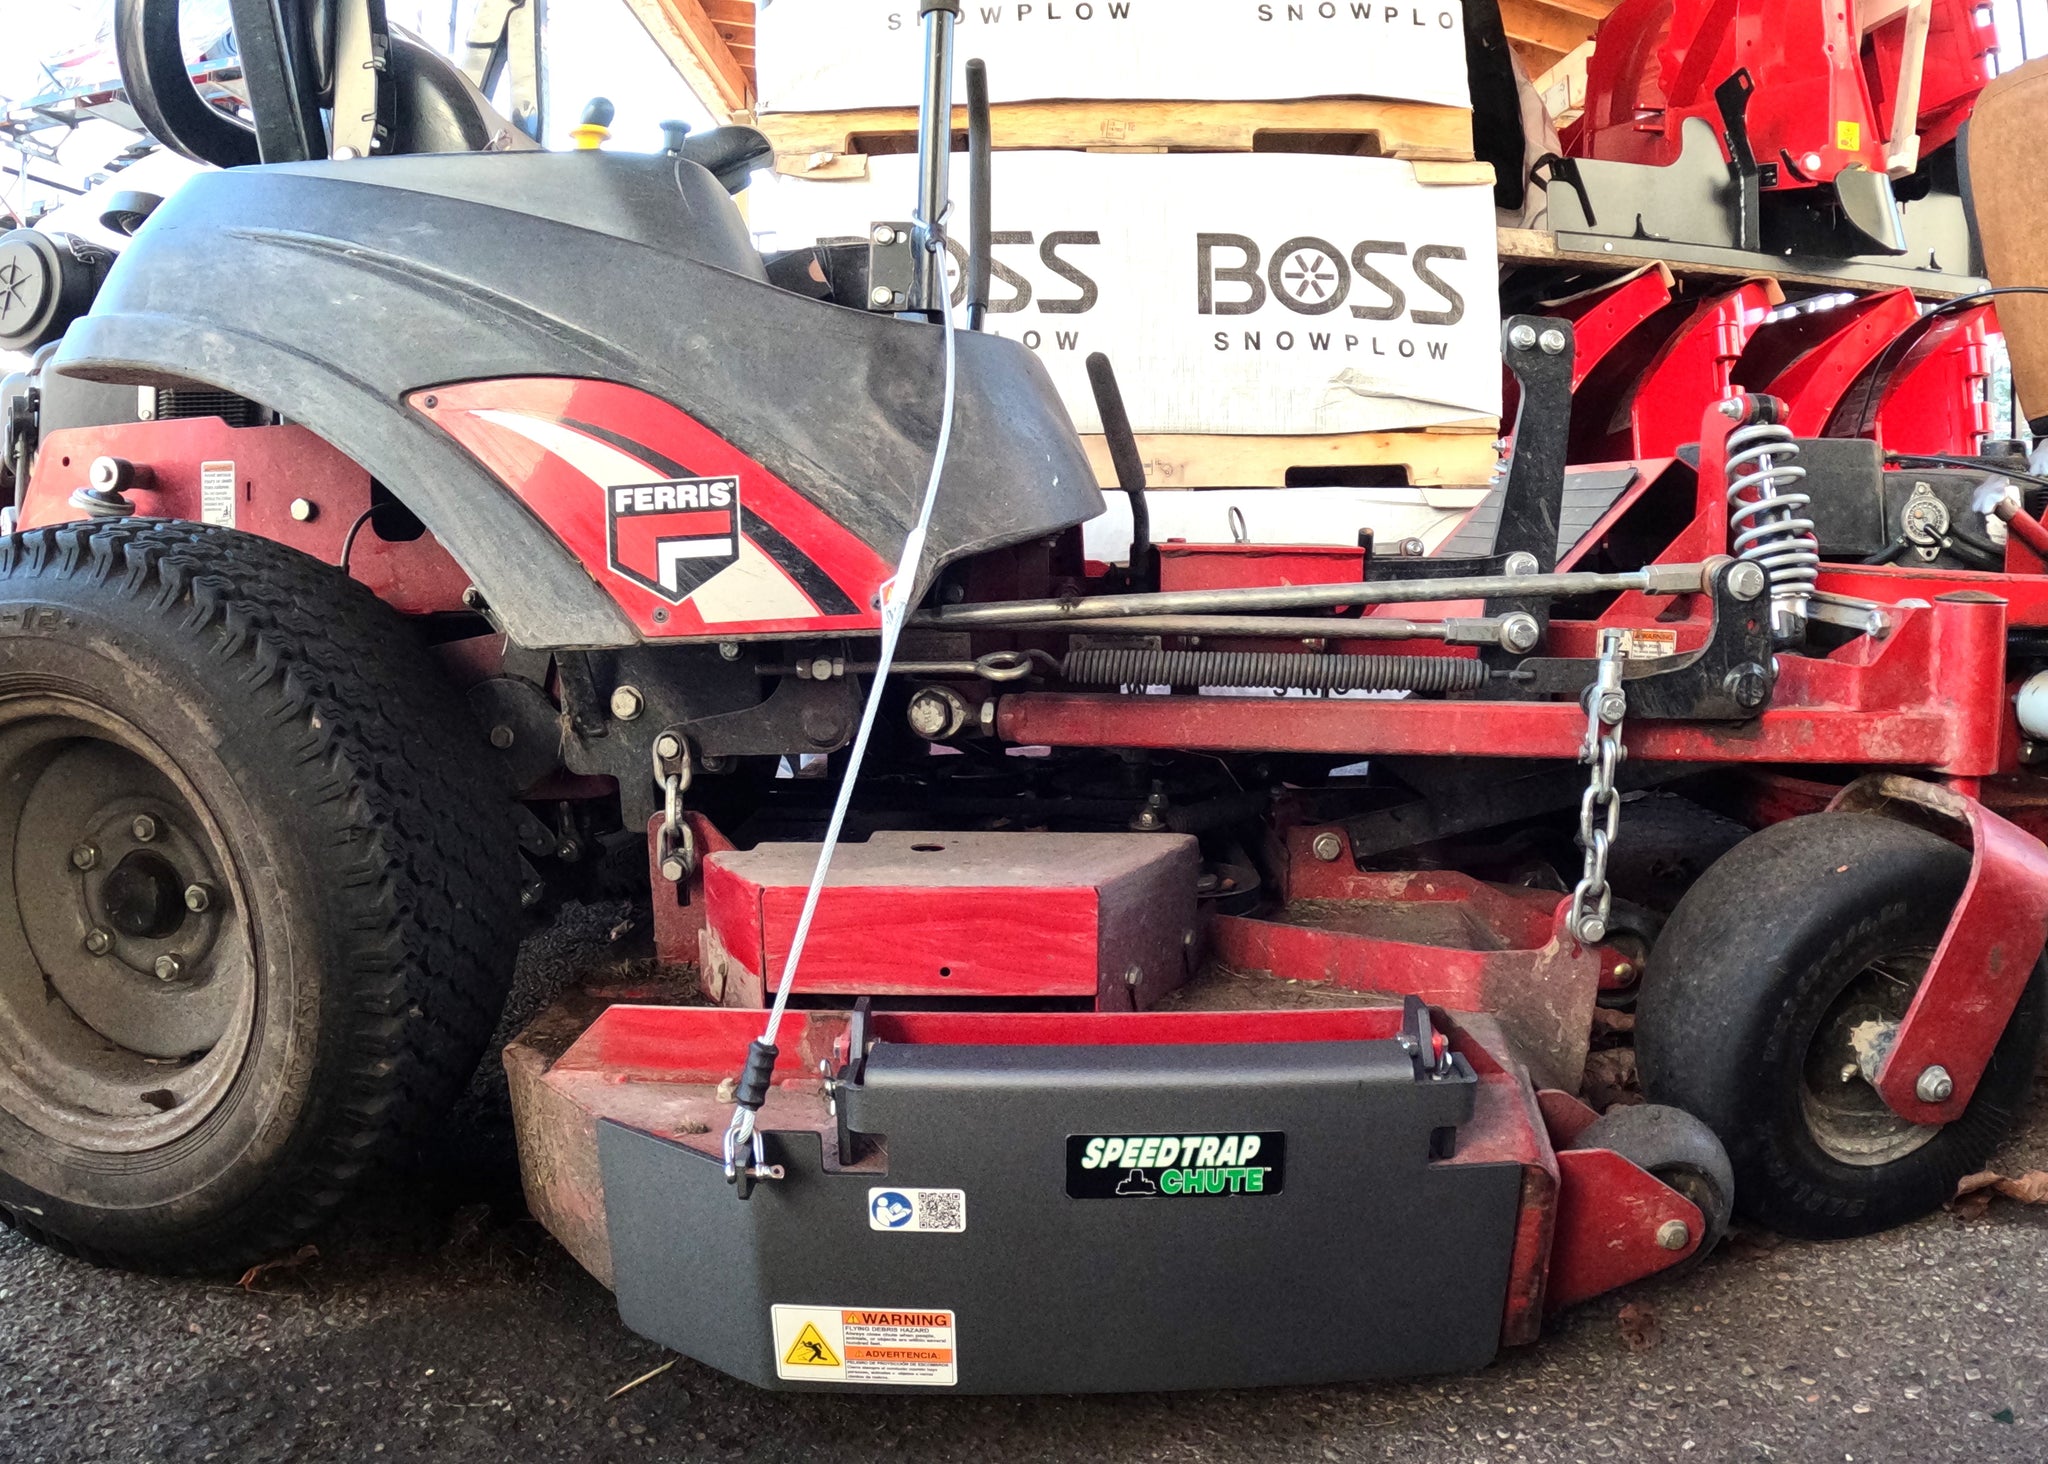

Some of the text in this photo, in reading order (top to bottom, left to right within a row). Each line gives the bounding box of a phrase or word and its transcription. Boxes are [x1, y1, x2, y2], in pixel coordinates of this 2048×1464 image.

[887, 2, 1131, 31] SOWPLOW
[1197, 232, 1468, 326] BOSS
[1214, 331, 1448, 360] SNOWPLOW
[615, 482, 731, 513] FERRIS
[1081, 1135, 1261, 1169] SPEEDTRAP
[862, 1312, 947, 1326] WARNING
